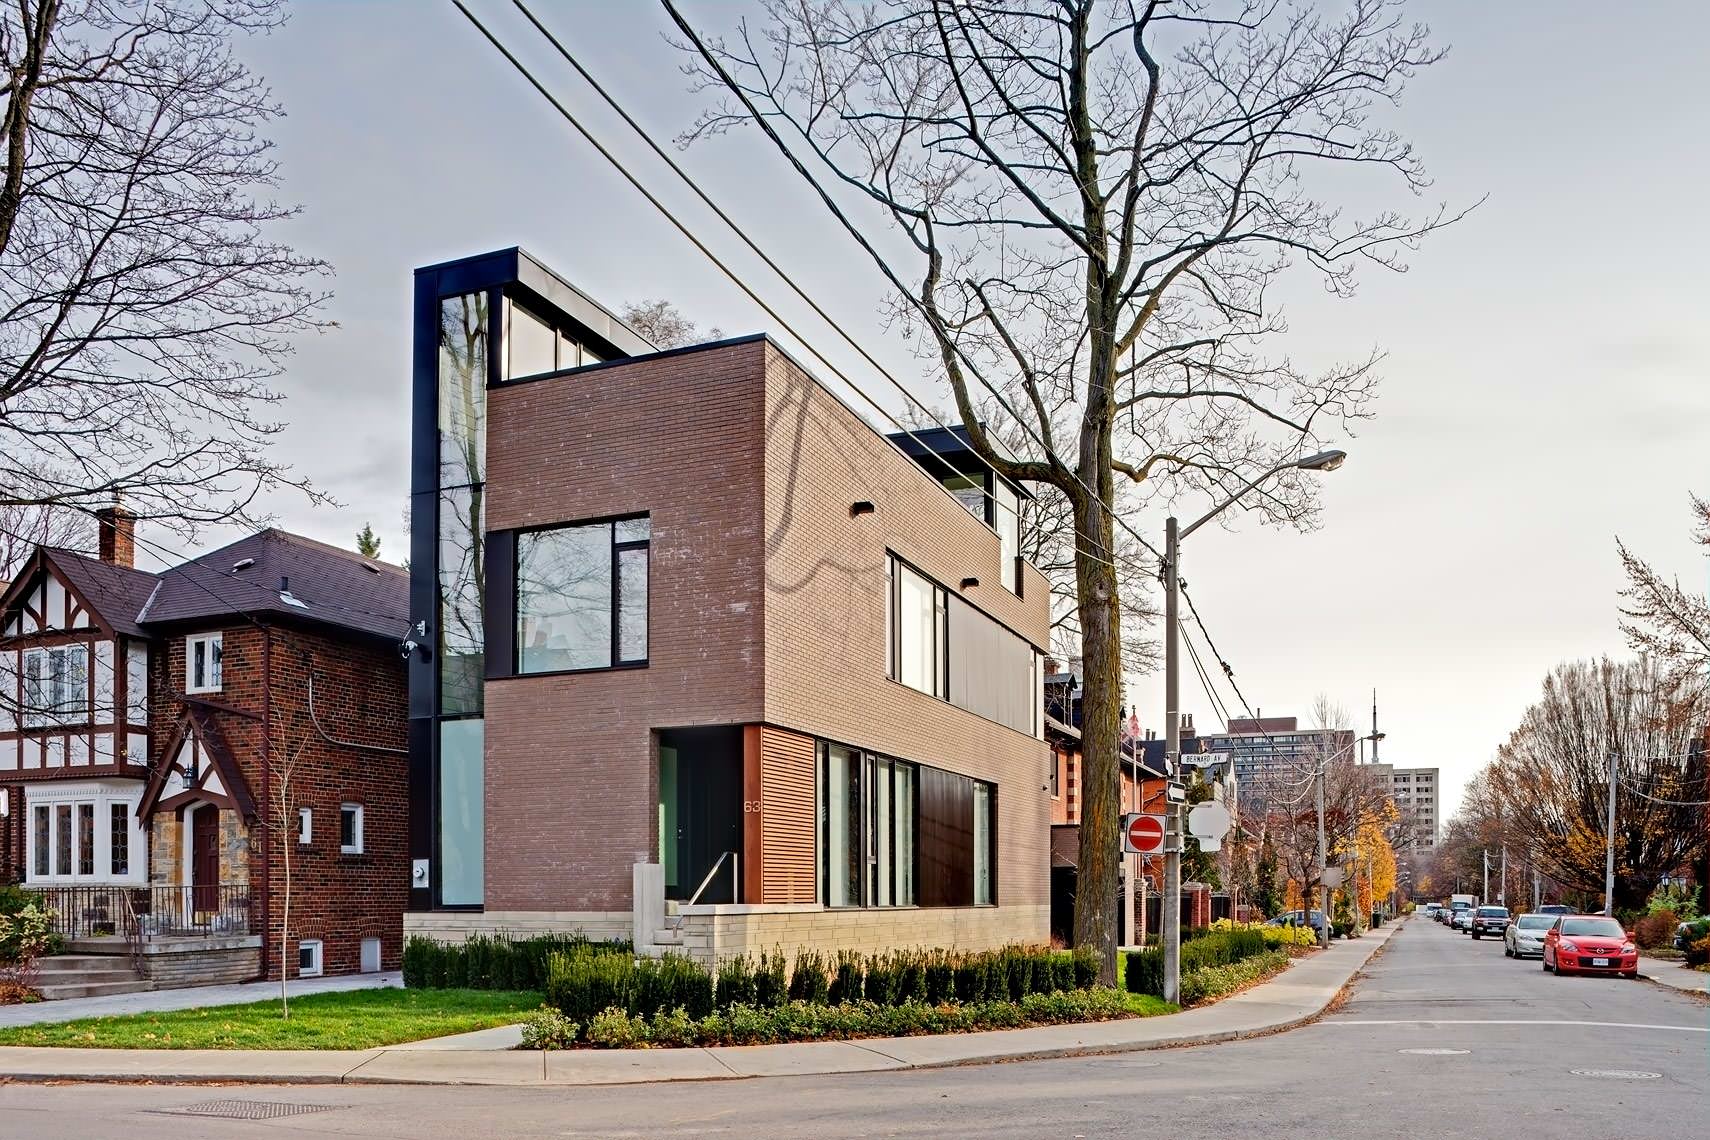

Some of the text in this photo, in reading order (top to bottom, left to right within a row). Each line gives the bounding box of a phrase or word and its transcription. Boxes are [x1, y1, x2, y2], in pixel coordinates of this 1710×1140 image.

[1186, 755, 1210, 763] BERNARD
[744, 801, 761, 812] 63
[251, 838, 262, 853] 61
